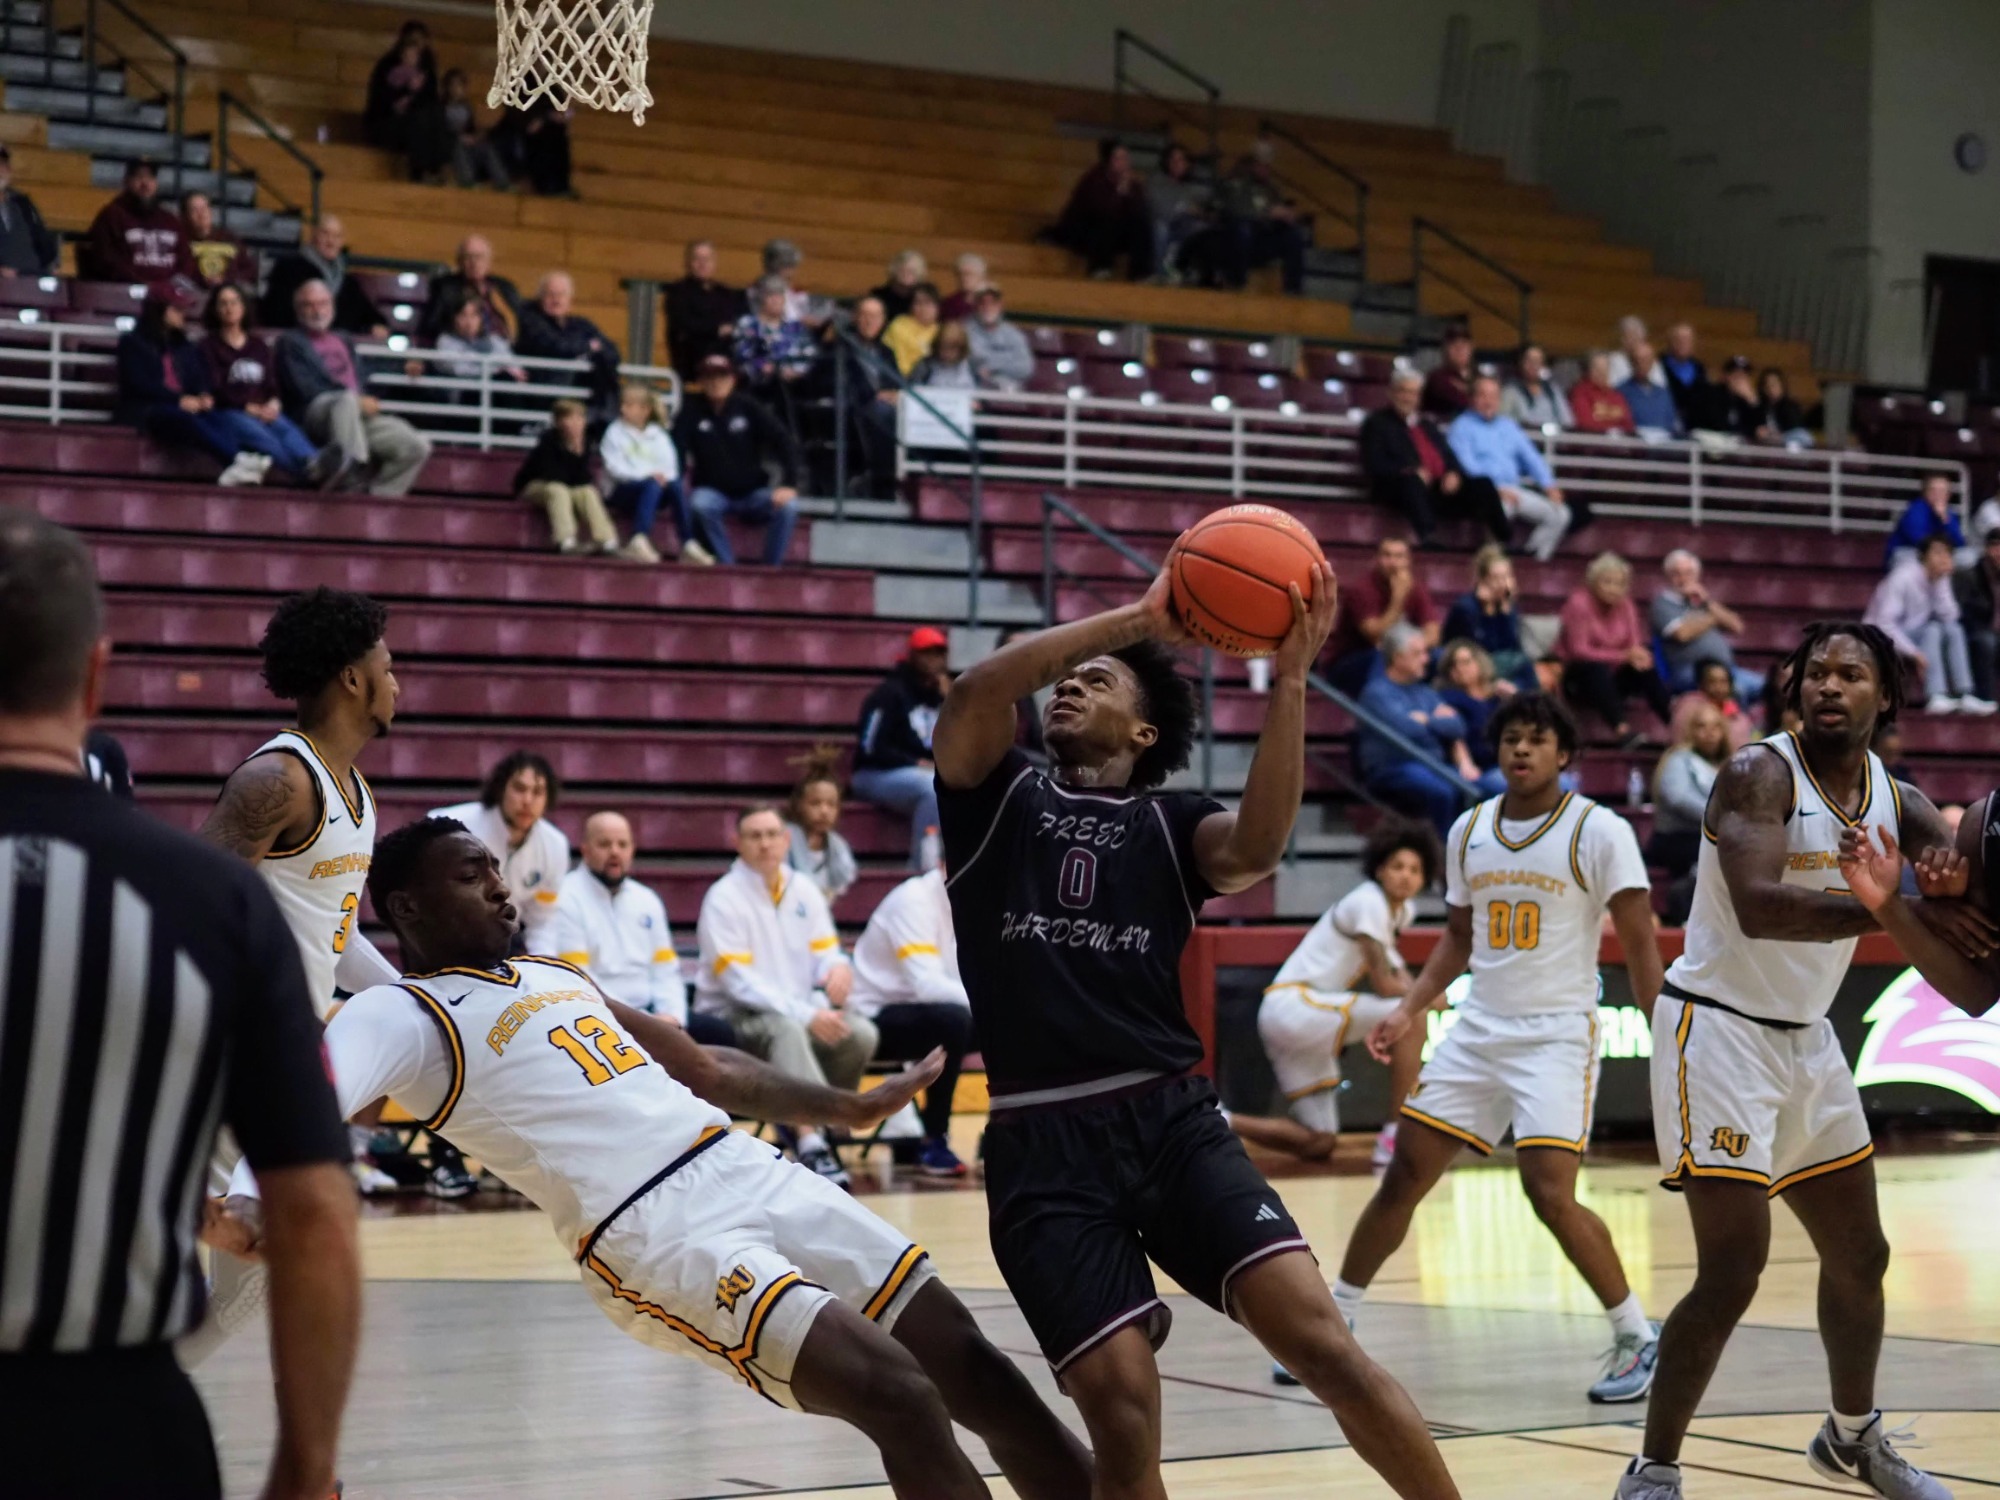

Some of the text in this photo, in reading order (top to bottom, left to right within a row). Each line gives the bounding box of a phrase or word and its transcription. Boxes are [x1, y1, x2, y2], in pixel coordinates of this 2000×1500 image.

[1036, 811, 1127, 849] FREED
[1057, 847, 1097, 910] 0
[333, 892, 358, 954] 3
[1001, 912, 1151, 954] HARDEMAN
[1487, 900, 1540, 950] 00
[547, 1015, 648, 1086] 12
[1709, 1127, 1750, 1158] RU
[715, 1263, 756, 1315] RU
